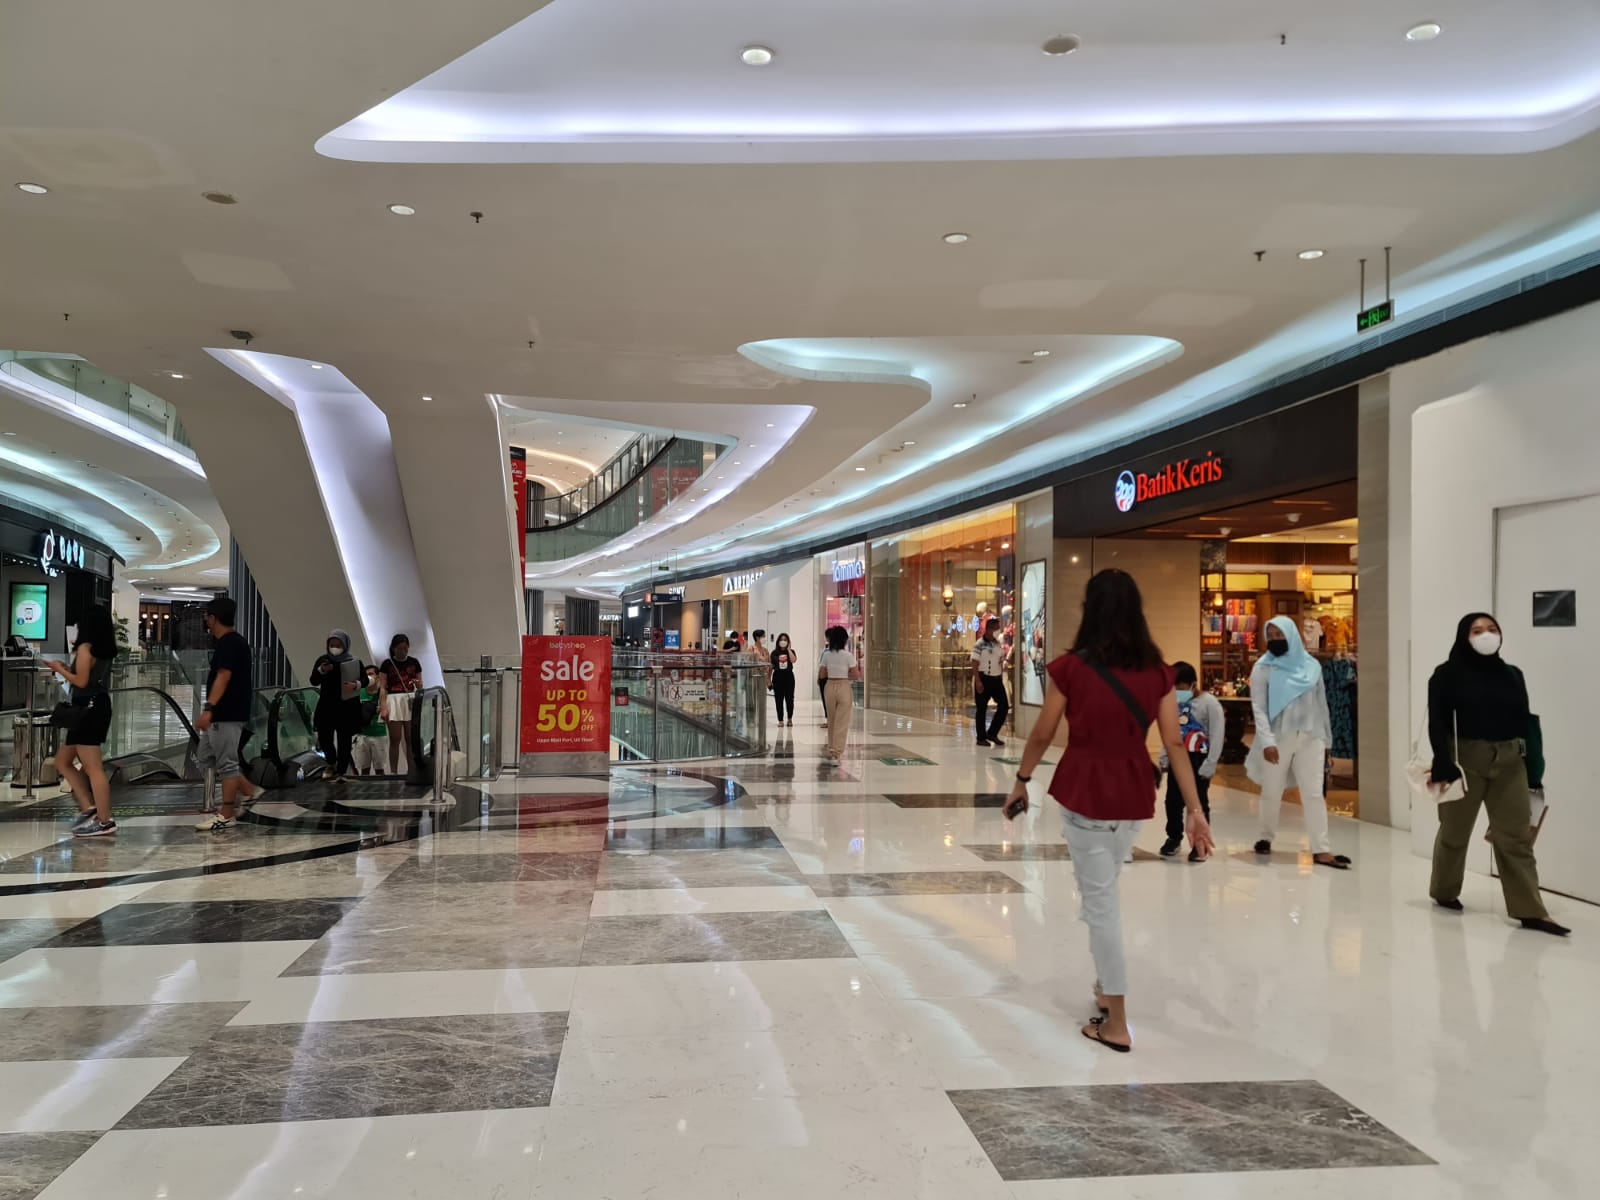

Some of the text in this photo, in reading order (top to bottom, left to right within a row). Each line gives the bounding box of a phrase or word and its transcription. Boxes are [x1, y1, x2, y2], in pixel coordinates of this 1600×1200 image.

[541, 655, 595, 681] sale
[546, 689, 588, 701] UP TO
